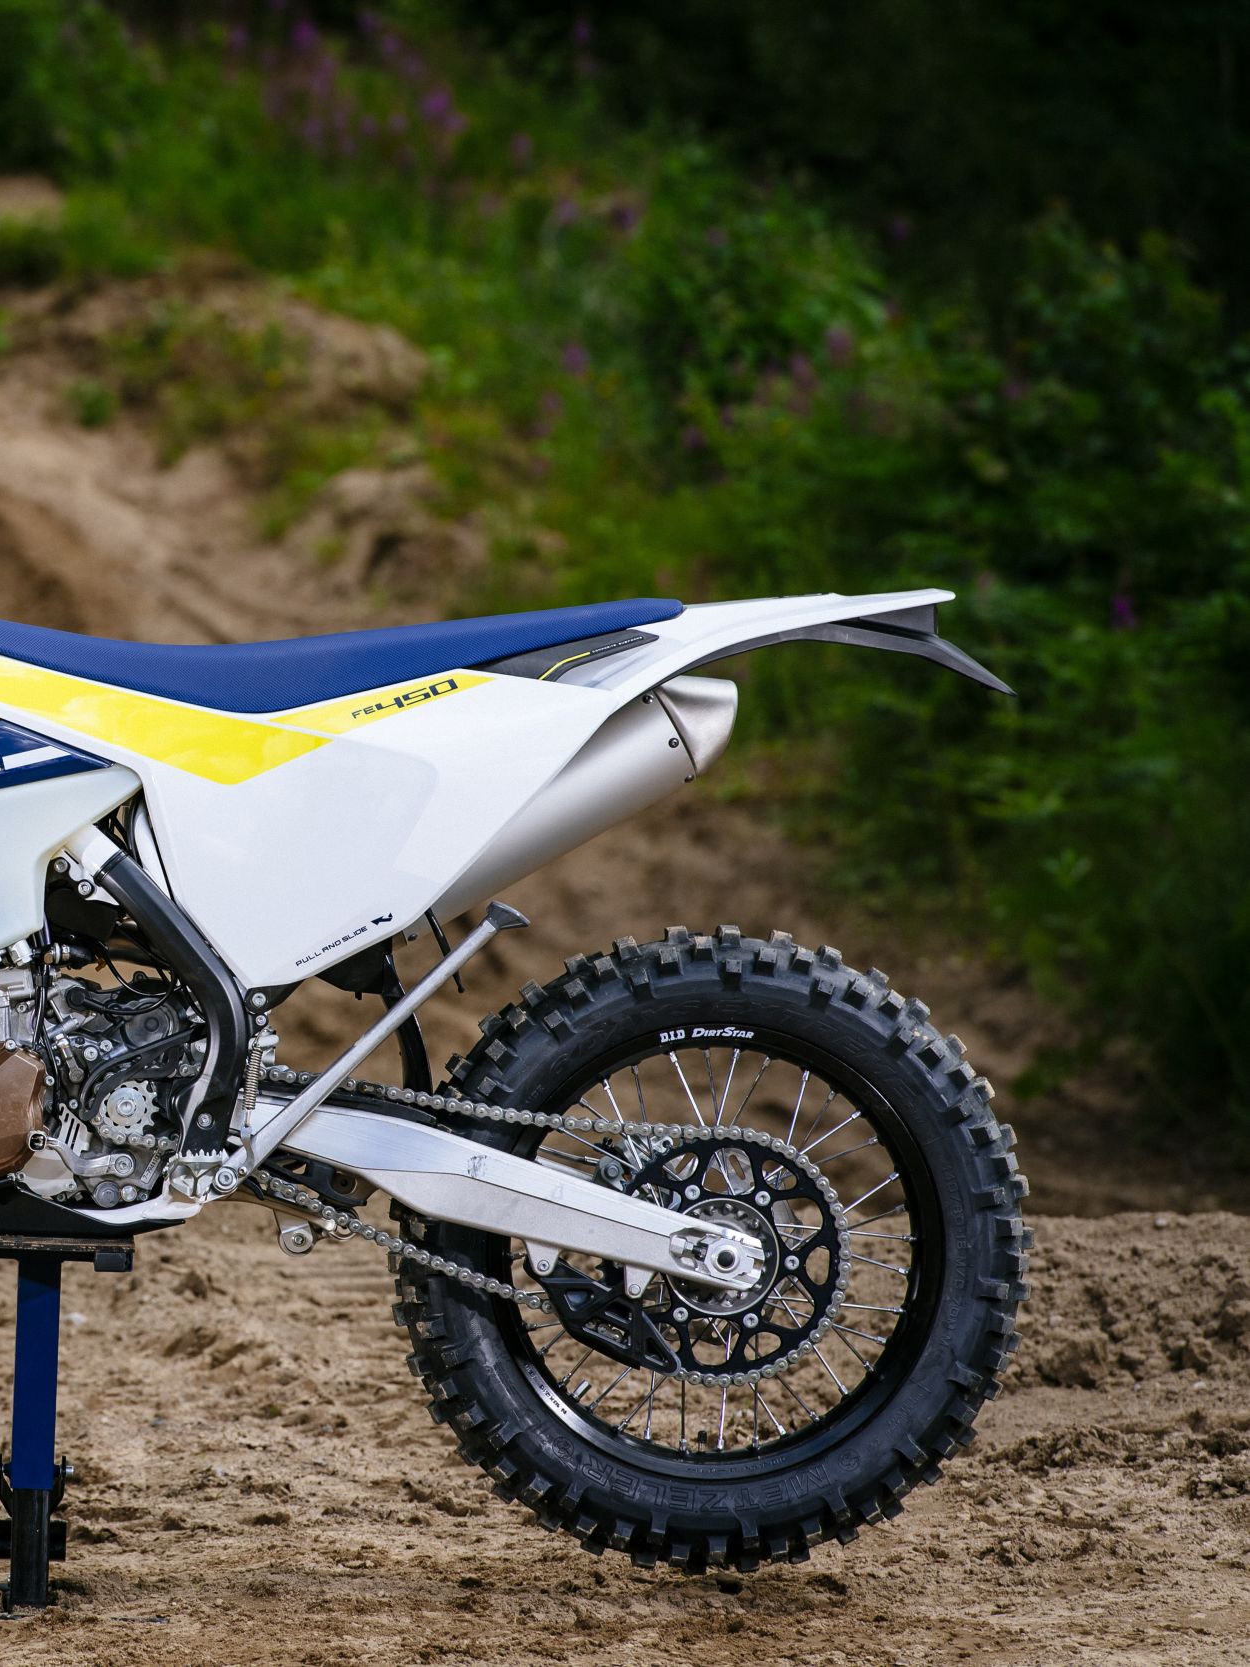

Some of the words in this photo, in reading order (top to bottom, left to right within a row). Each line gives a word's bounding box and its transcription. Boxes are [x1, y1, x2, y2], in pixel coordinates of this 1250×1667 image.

[295, 952, 323, 967] PULL
[321, 940, 342, 954] AND
[341, 926, 368, 943] SLIDE
[577, 1452, 834, 1511] METZELER
